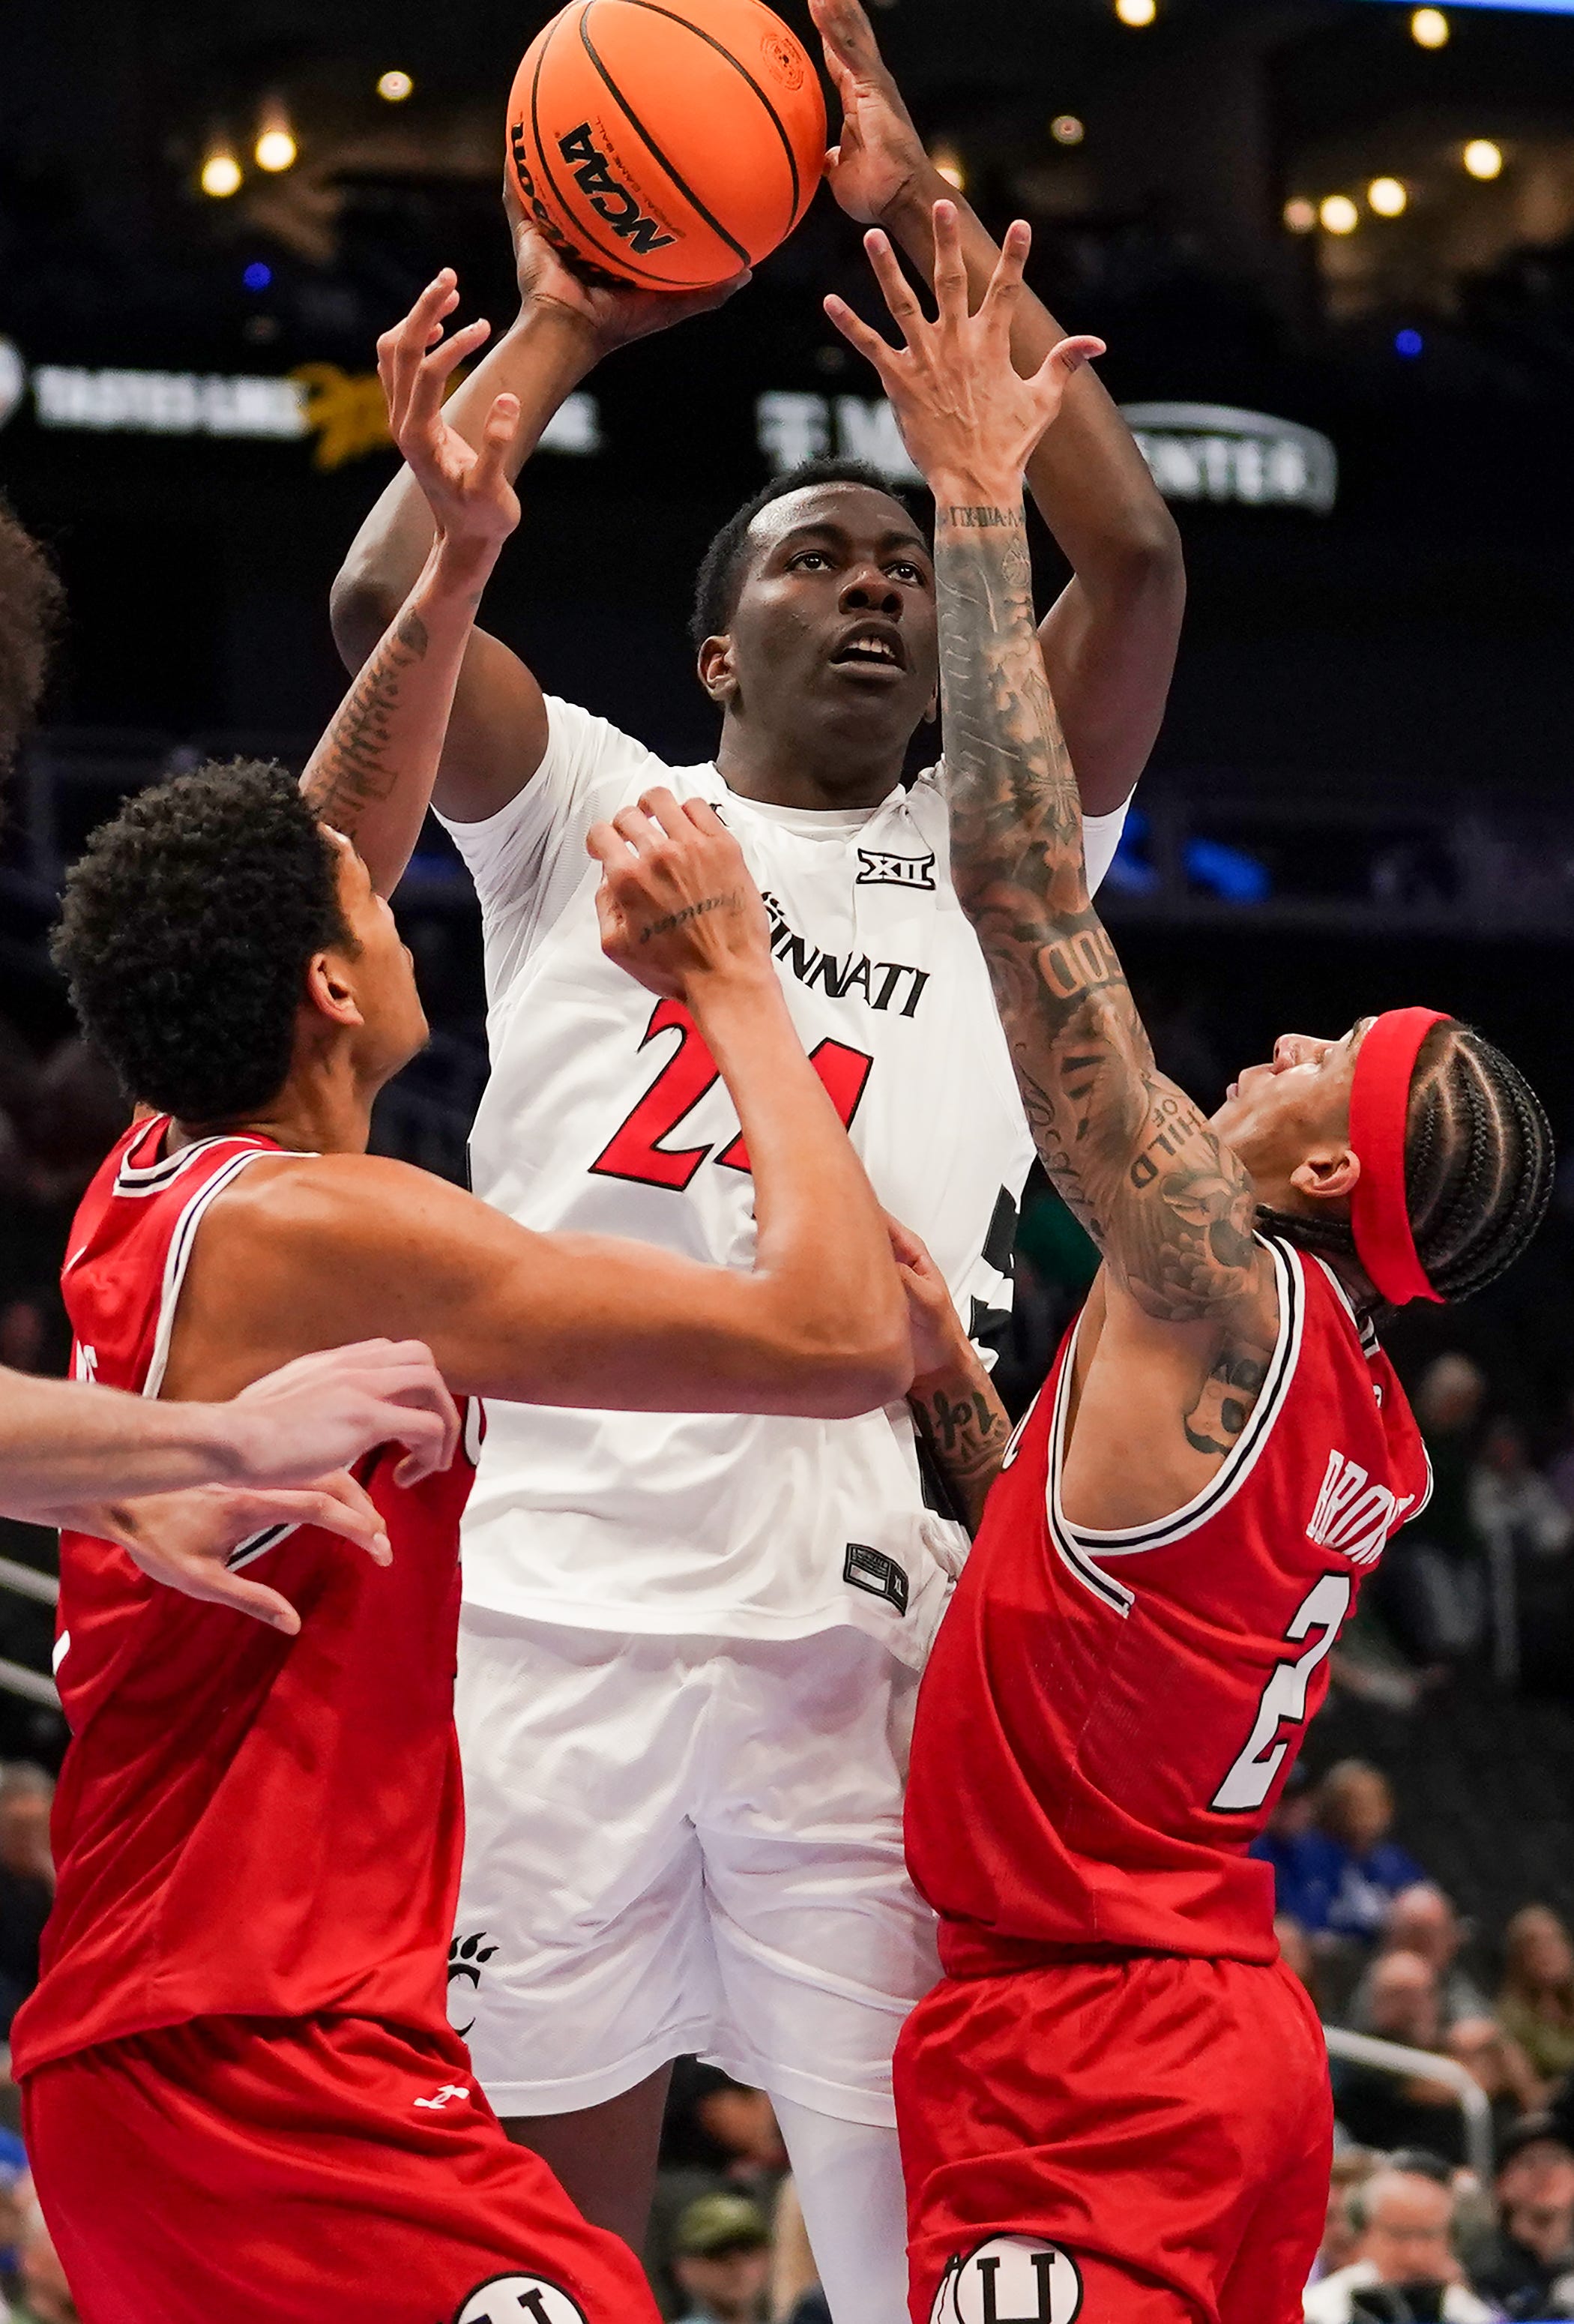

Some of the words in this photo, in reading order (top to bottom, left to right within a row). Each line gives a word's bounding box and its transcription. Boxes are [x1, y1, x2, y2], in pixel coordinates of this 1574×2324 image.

[558, 120, 678, 256] NCAA
[856, 848, 935, 890] XII
[765, 903, 930, 1018] INNATI
[1130, 1107, 1207, 1189] HILD
[1208, 1571, 1351, 1813] 2
